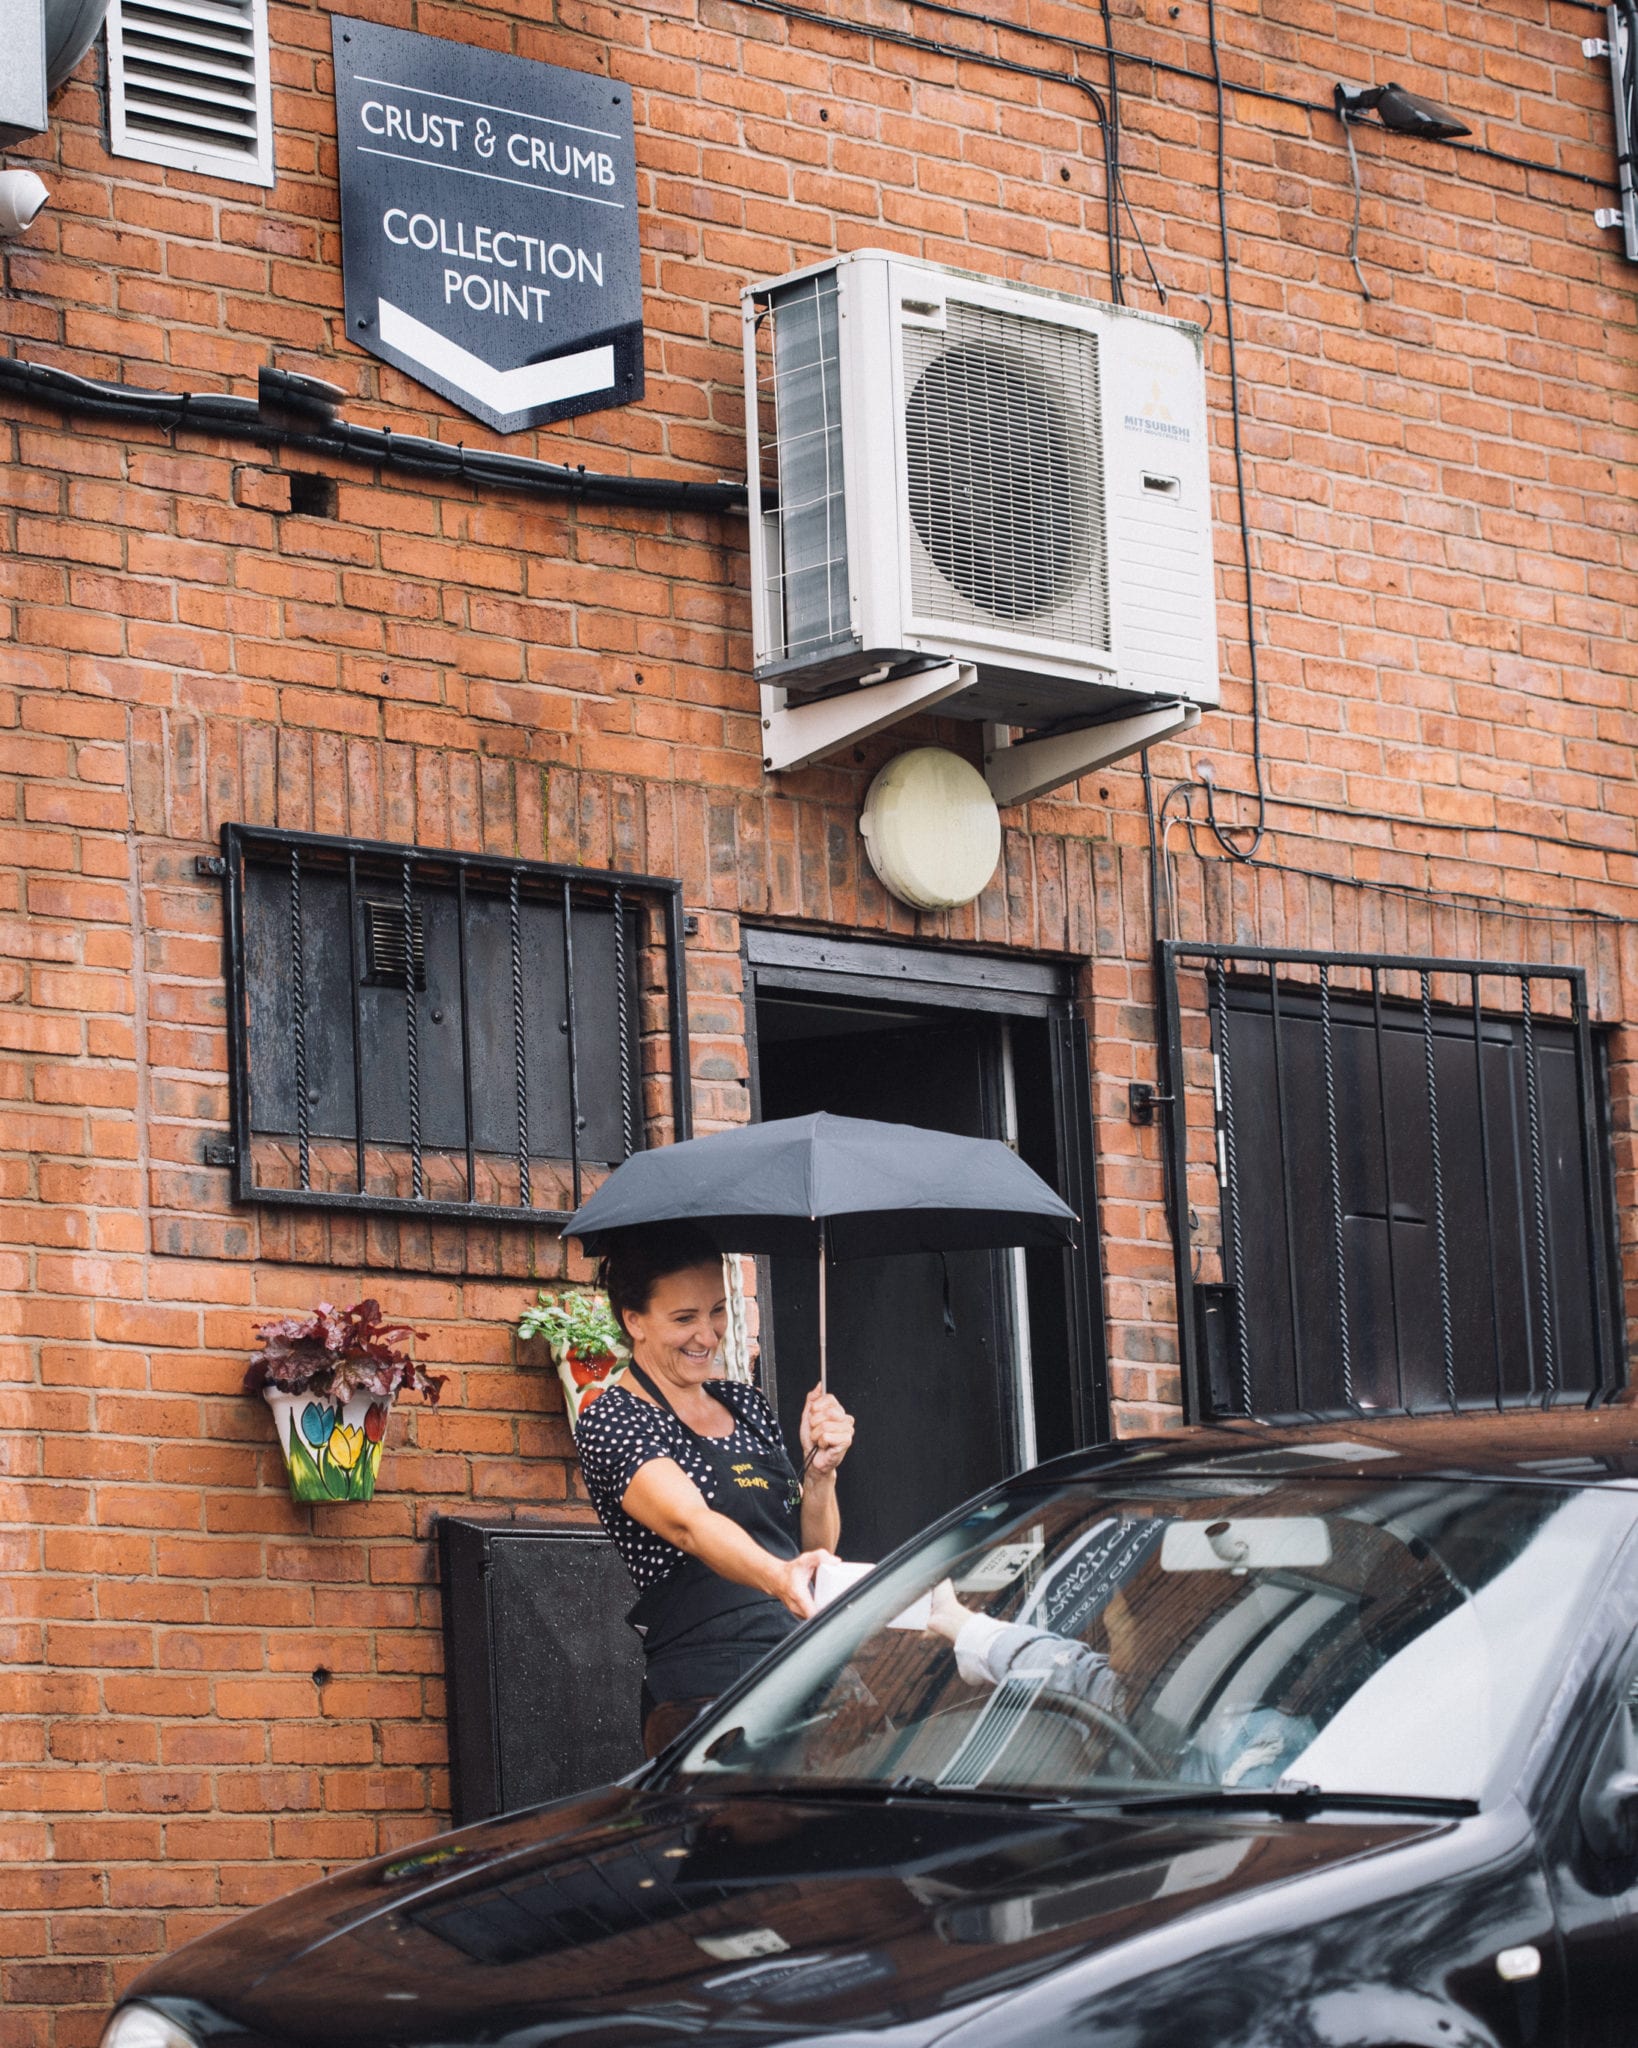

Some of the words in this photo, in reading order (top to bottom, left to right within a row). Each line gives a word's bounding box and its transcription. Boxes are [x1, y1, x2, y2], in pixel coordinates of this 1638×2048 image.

[361, 101, 464, 151] CRUST
[474, 117, 496, 158] &
[507, 134, 616, 186] CRUMB
[383, 208, 604, 287] COLLECTION
[444, 269, 550, 323] POINT
[1124, 415, 1190, 437] MITSUBISHI
